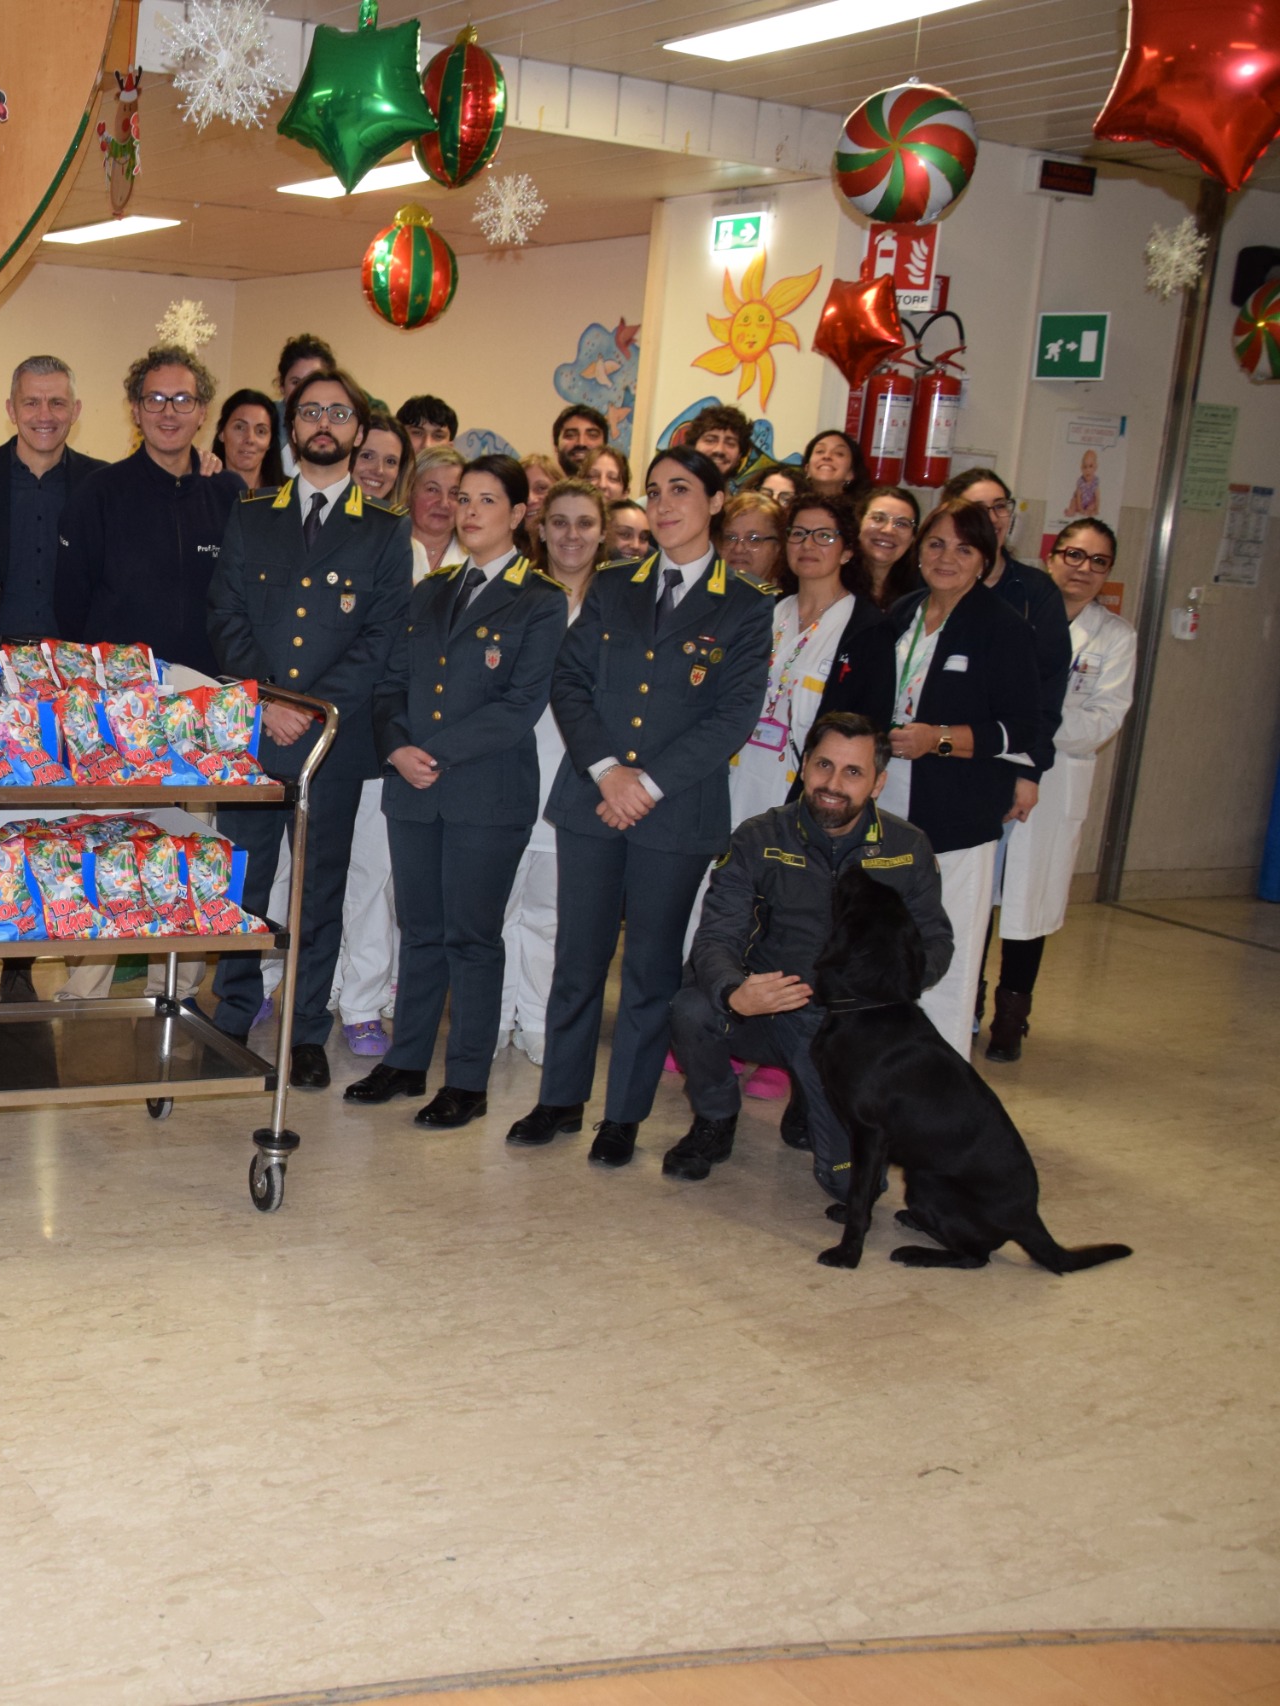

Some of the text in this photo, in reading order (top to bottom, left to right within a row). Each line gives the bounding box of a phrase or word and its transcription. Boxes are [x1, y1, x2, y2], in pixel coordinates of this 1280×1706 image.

[20, 750, 53, 769] TOM
[79, 748, 105, 767] TOM
[49, 897, 78, 918] TOM
[107, 897, 136, 916] TOM
[200, 897, 226, 919] TOM
[54, 911, 94, 937] JERRY
